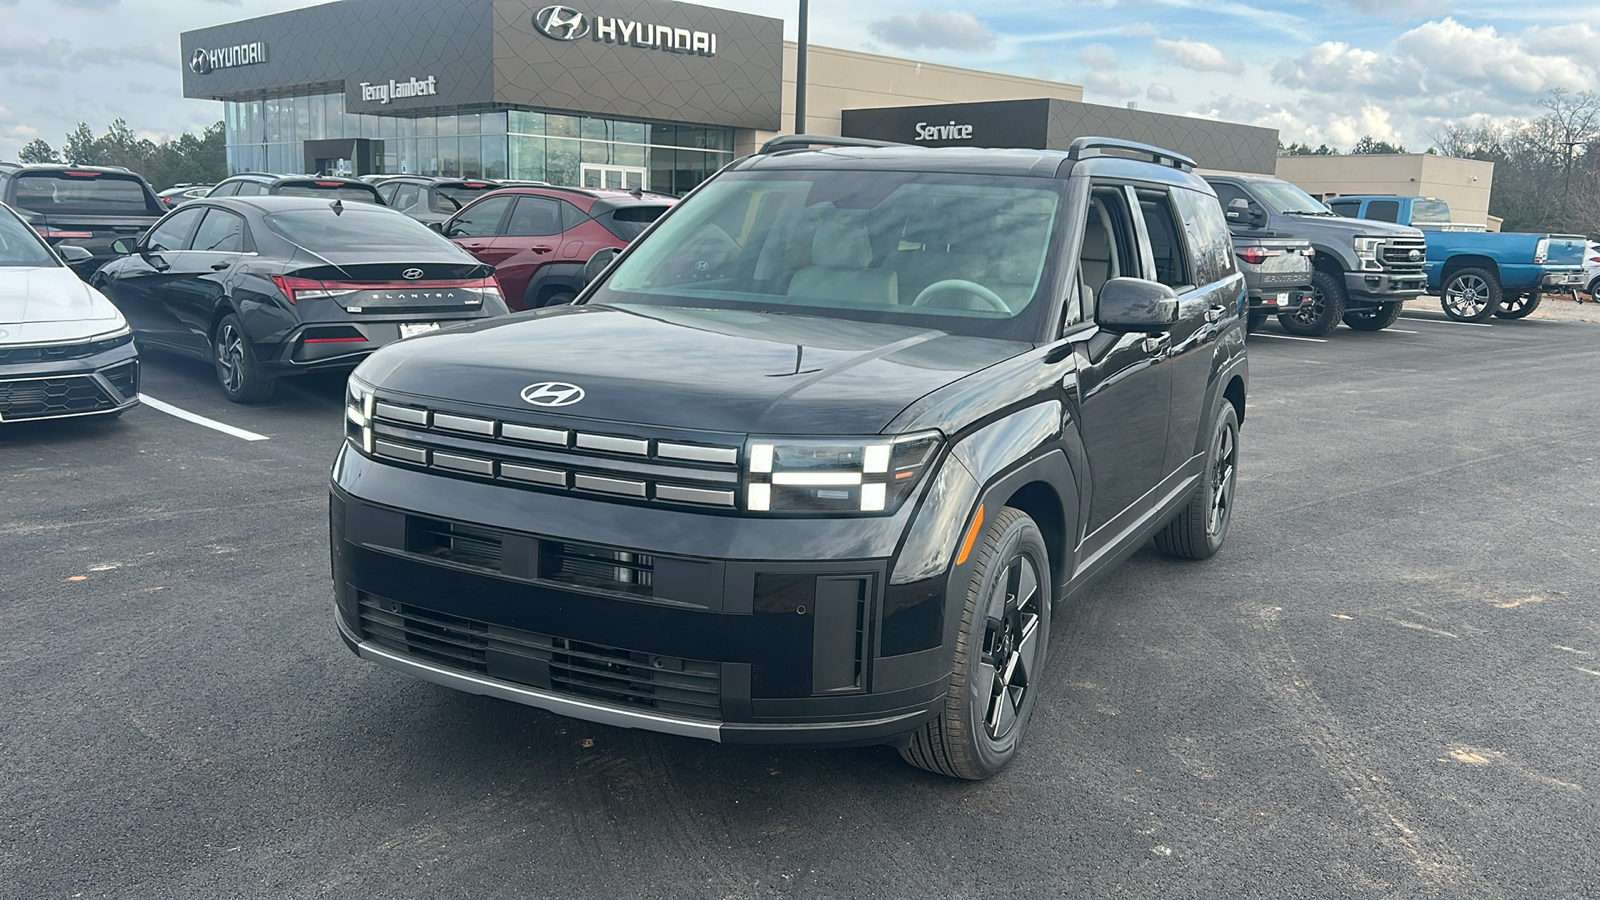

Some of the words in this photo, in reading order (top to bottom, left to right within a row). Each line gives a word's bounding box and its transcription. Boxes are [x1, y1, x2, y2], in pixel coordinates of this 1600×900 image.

[597, 16, 717, 54] HYUNDAI
[209, 42, 267, 69] HYUNDAI
[359, 82, 389, 104] Terry
[389, 75, 436, 98] Lambert
[914, 120, 973, 141] Service
